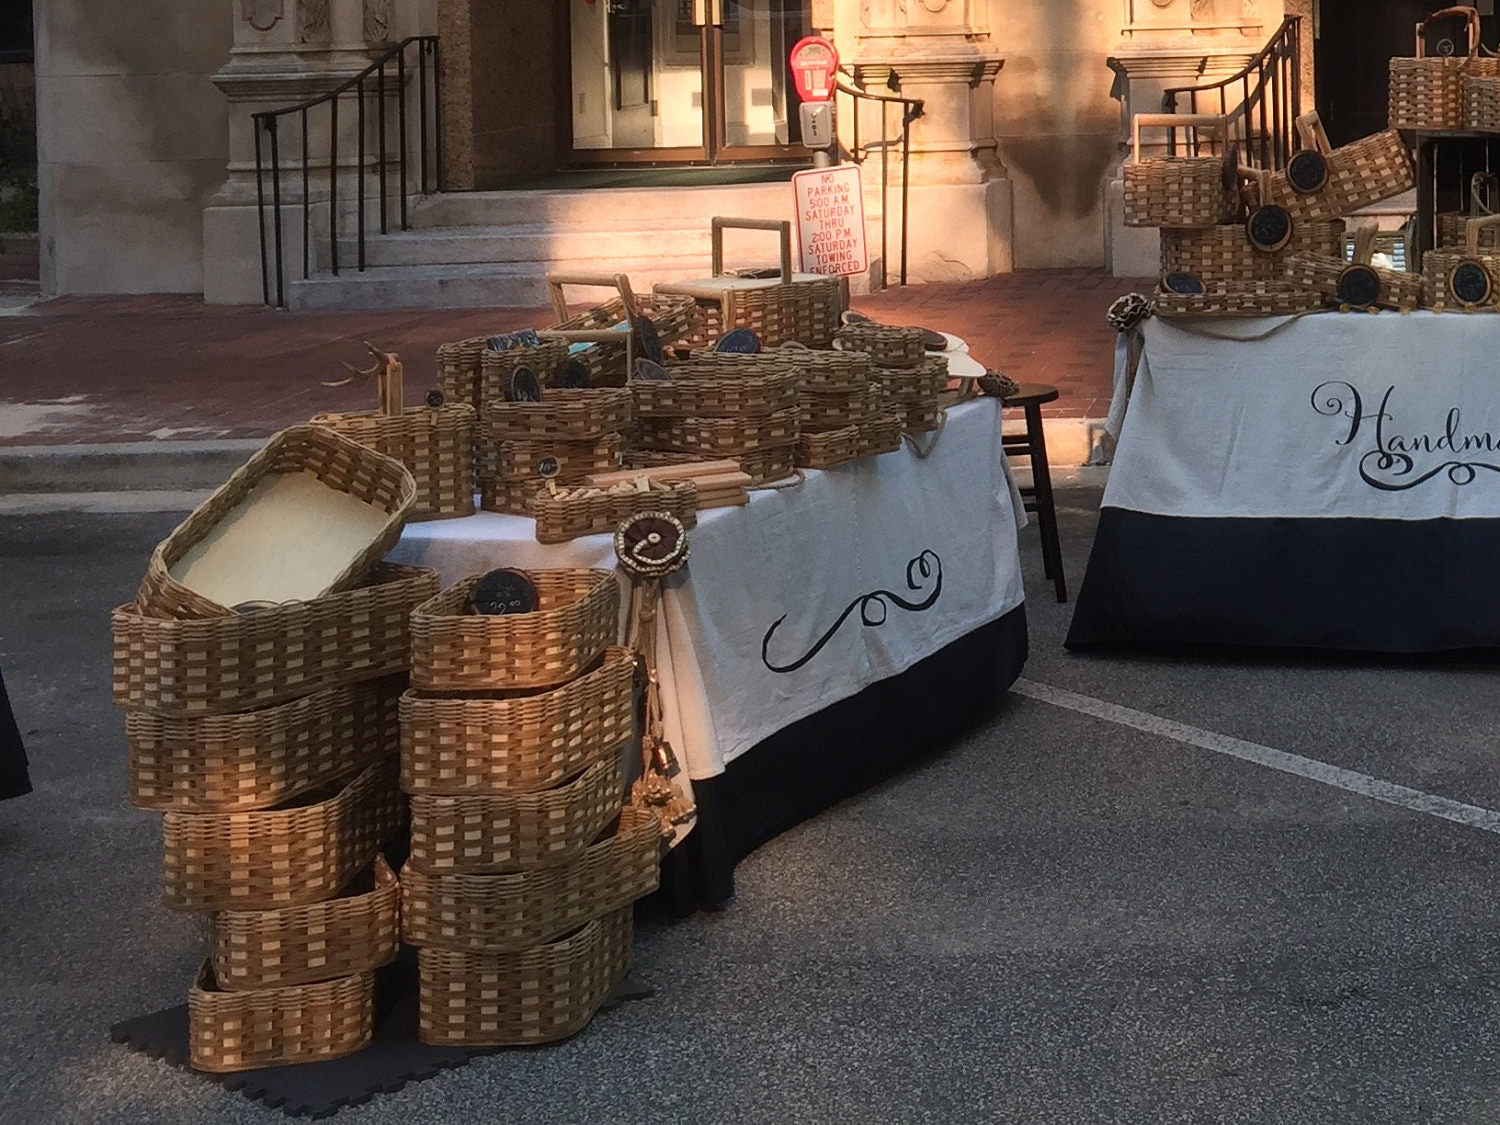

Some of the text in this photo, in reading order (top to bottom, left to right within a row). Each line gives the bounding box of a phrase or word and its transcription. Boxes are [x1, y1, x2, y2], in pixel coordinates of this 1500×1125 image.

[821, 173, 835, 184] NO
[807, 182, 850, 197] PARKING
[805, 204, 856, 221] SATURDAY
[819, 217, 845, 230] THRU
[808, 238, 858, 255] SATURDAY
[816, 250, 853, 265] TOWING
[810, 260, 861, 275] ENFORCED
